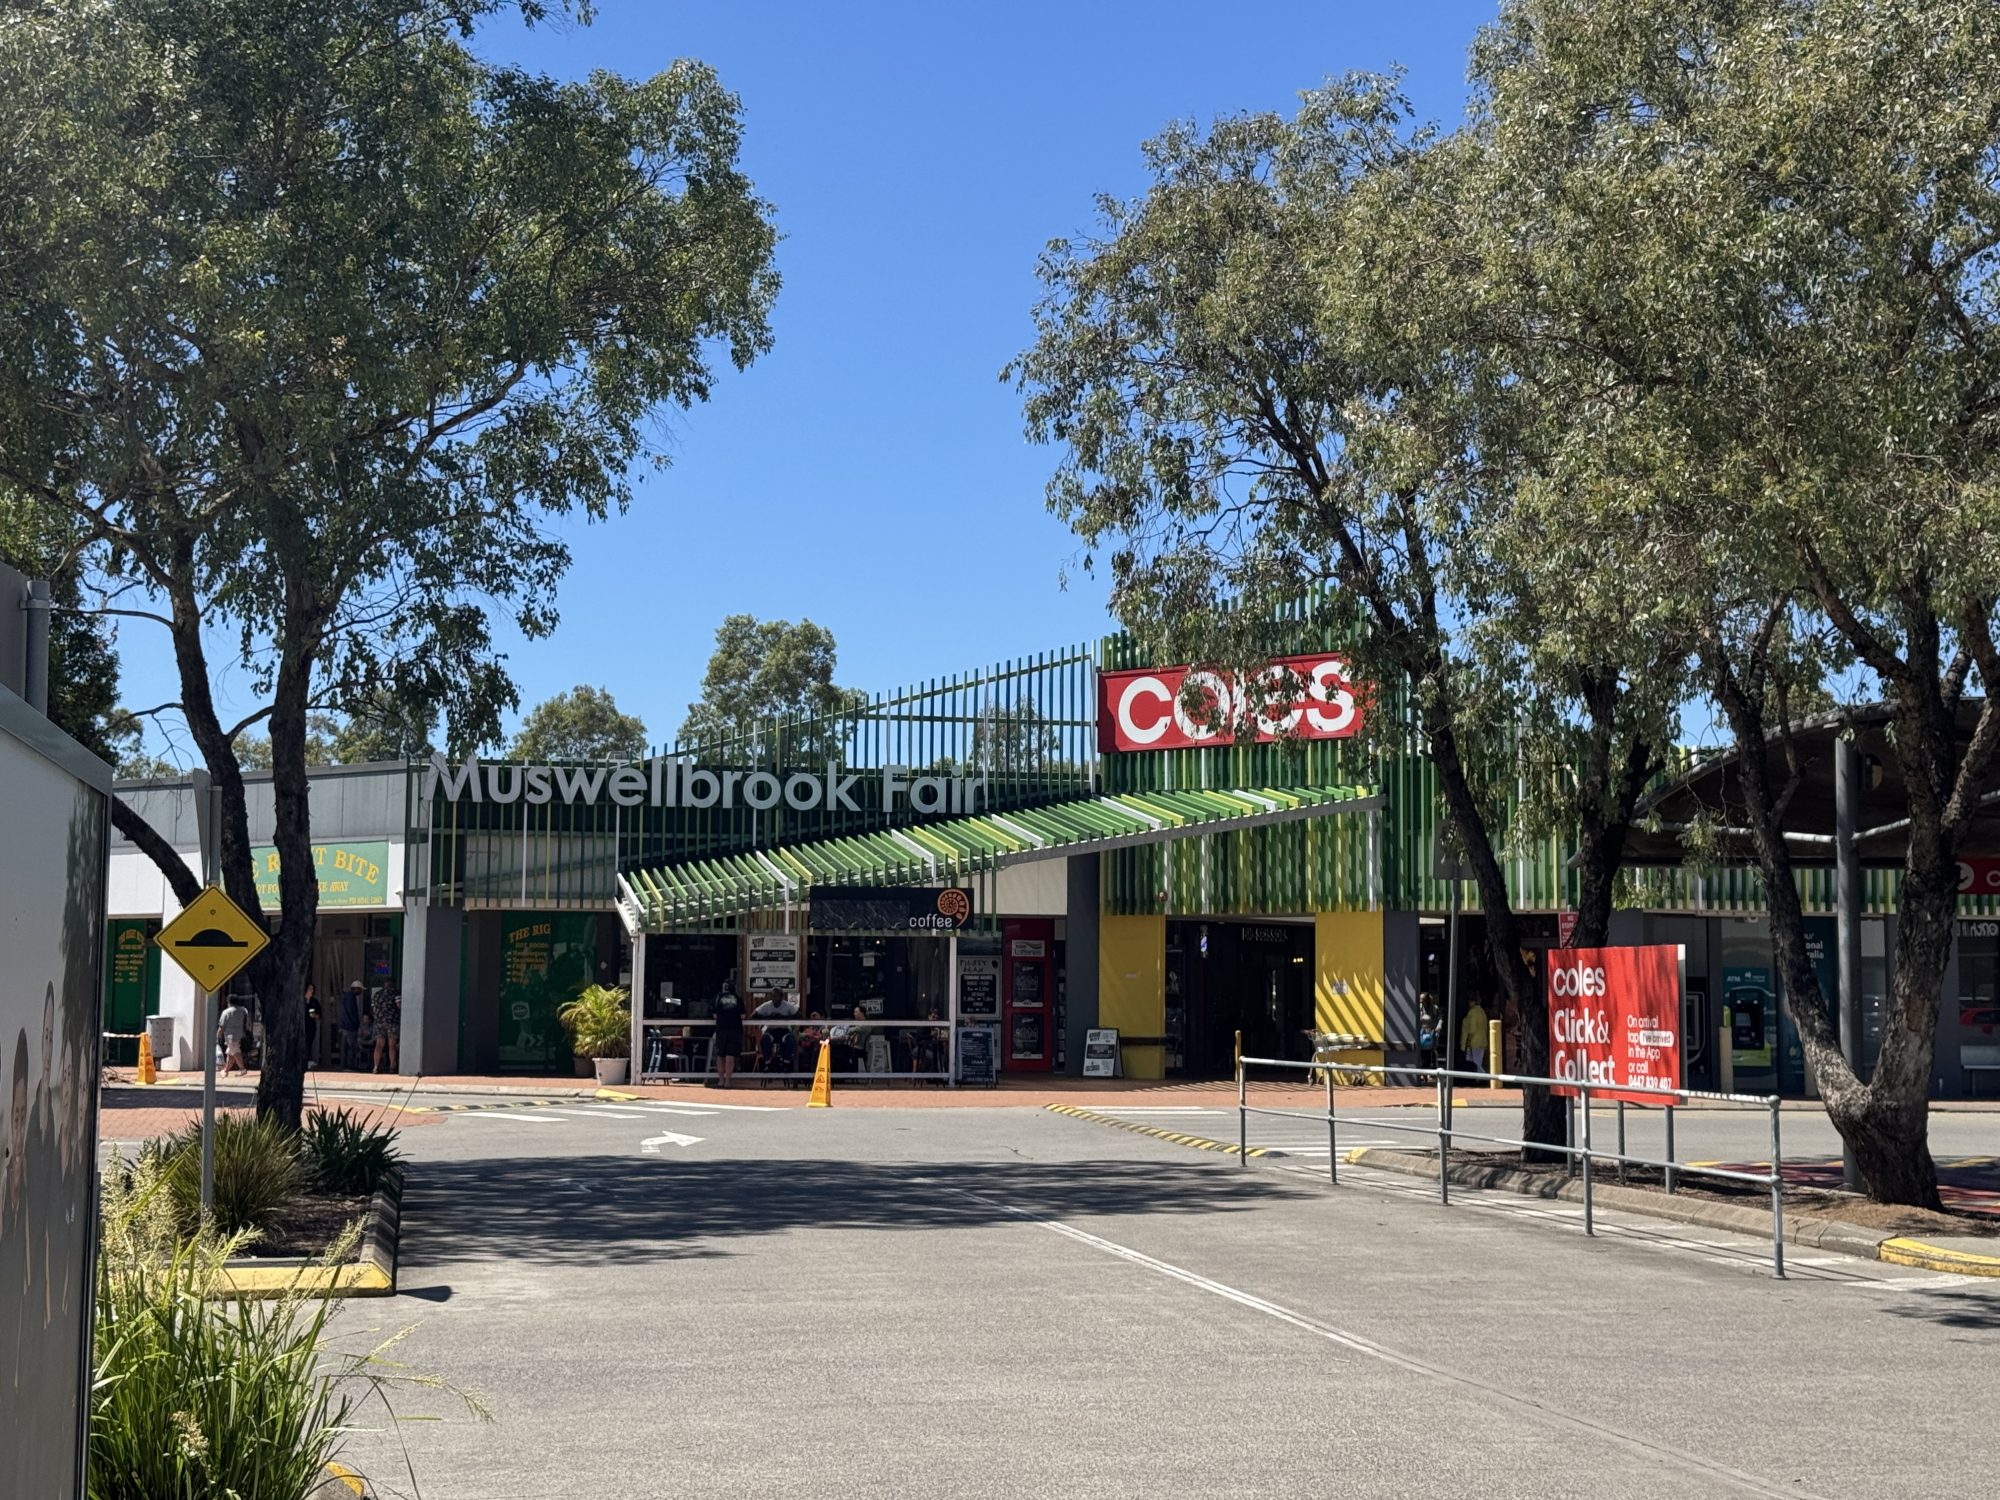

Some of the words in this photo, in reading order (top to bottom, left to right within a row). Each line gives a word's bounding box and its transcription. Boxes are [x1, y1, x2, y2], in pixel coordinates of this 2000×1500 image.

[1118, 660, 1356, 744] coles
[422, 752, 862, 811] Muswellbrook
[882, 764, 984, 815] Fair
[335, 849, 379, 885] BITE
[330, 881, 349, 892] AWAY
[909, 913, 952, 928] coffee
[508, 927, 529, 943] THE
[1806, 940, 1823, 949] onal
[1553, 960, 1605, 997] coles
[1726, 975, 1741, 983] ATM
[1627, 1014, 1637, 1028] On
[1639, 1015, 1658, 1028] arrival
[1627, 1030, 1639, 1045] tap
[1652, 1033, 1670, 1043] arrived
[1628, 1045, 1634, 1058] in
[1635, 1046, 1645, 1059] the
[1647, 1047, 1660, 1062] App
[1555, 1049, 1615, 1085] Collect
[1628, 1062, 1636, 1073] or
[1636, 1061, 1649, 1073] call
